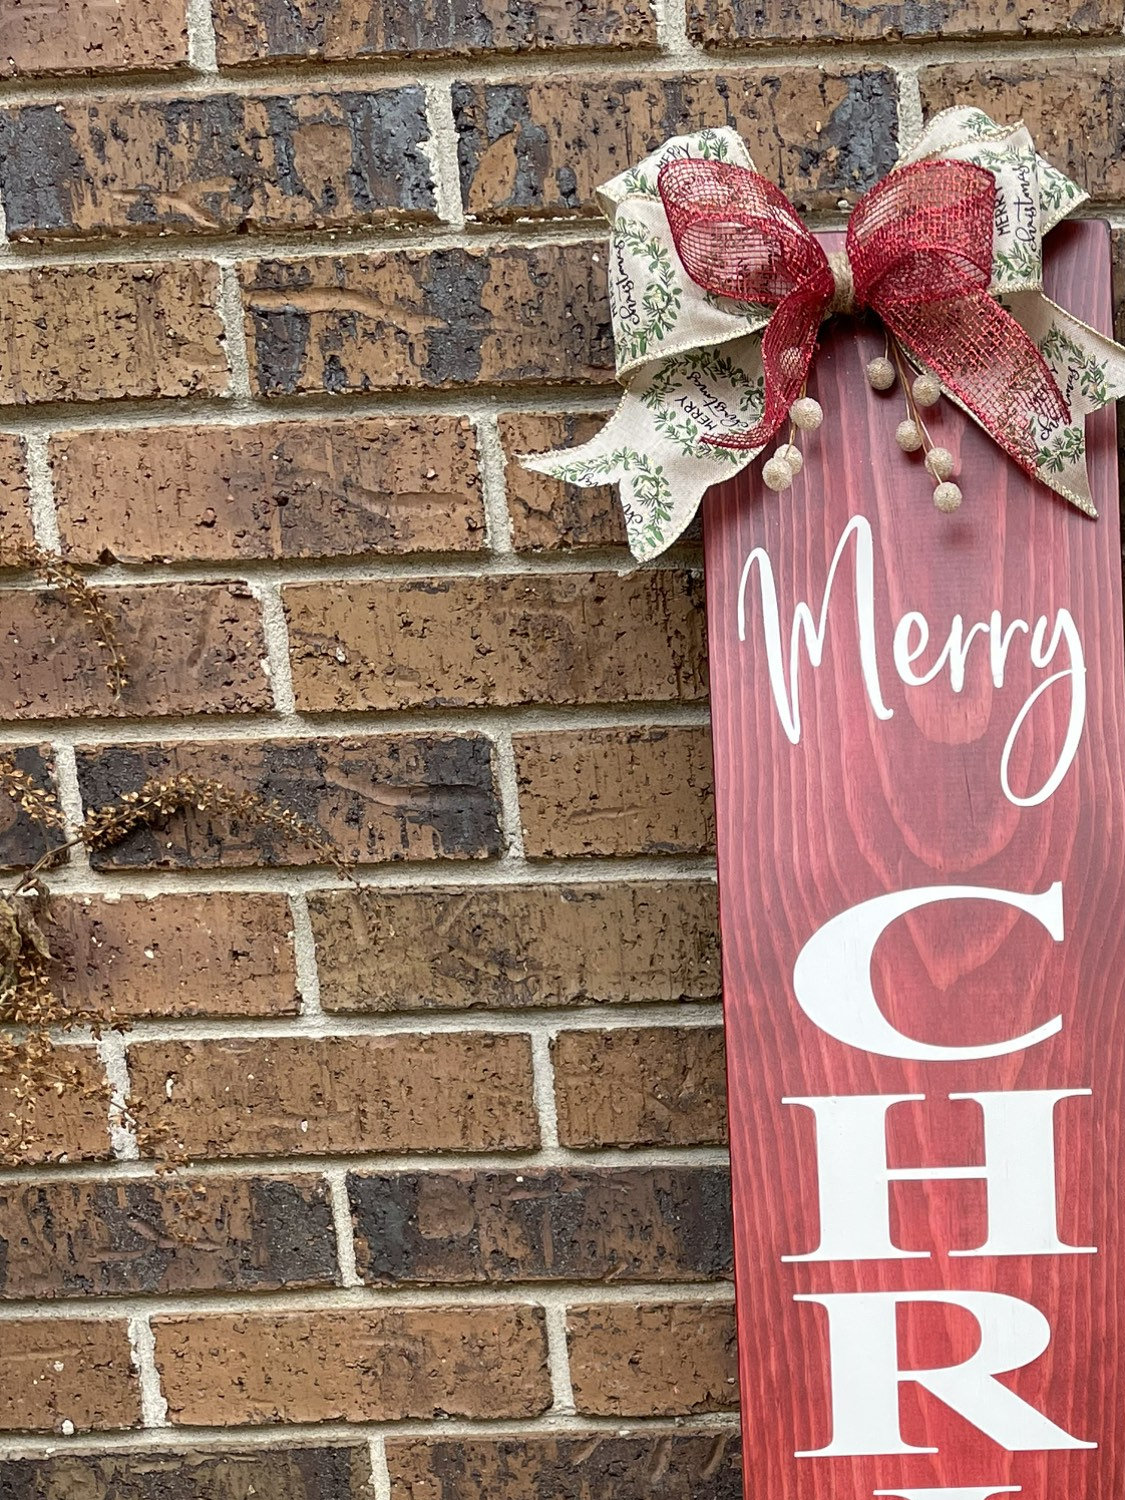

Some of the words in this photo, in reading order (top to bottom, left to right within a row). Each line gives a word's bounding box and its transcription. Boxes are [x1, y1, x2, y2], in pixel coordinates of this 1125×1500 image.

[993, 185, 1011, 237] MERRY
[674, 395, 718, 431] MERRY
[737, 513, 1088, 807] Merry
